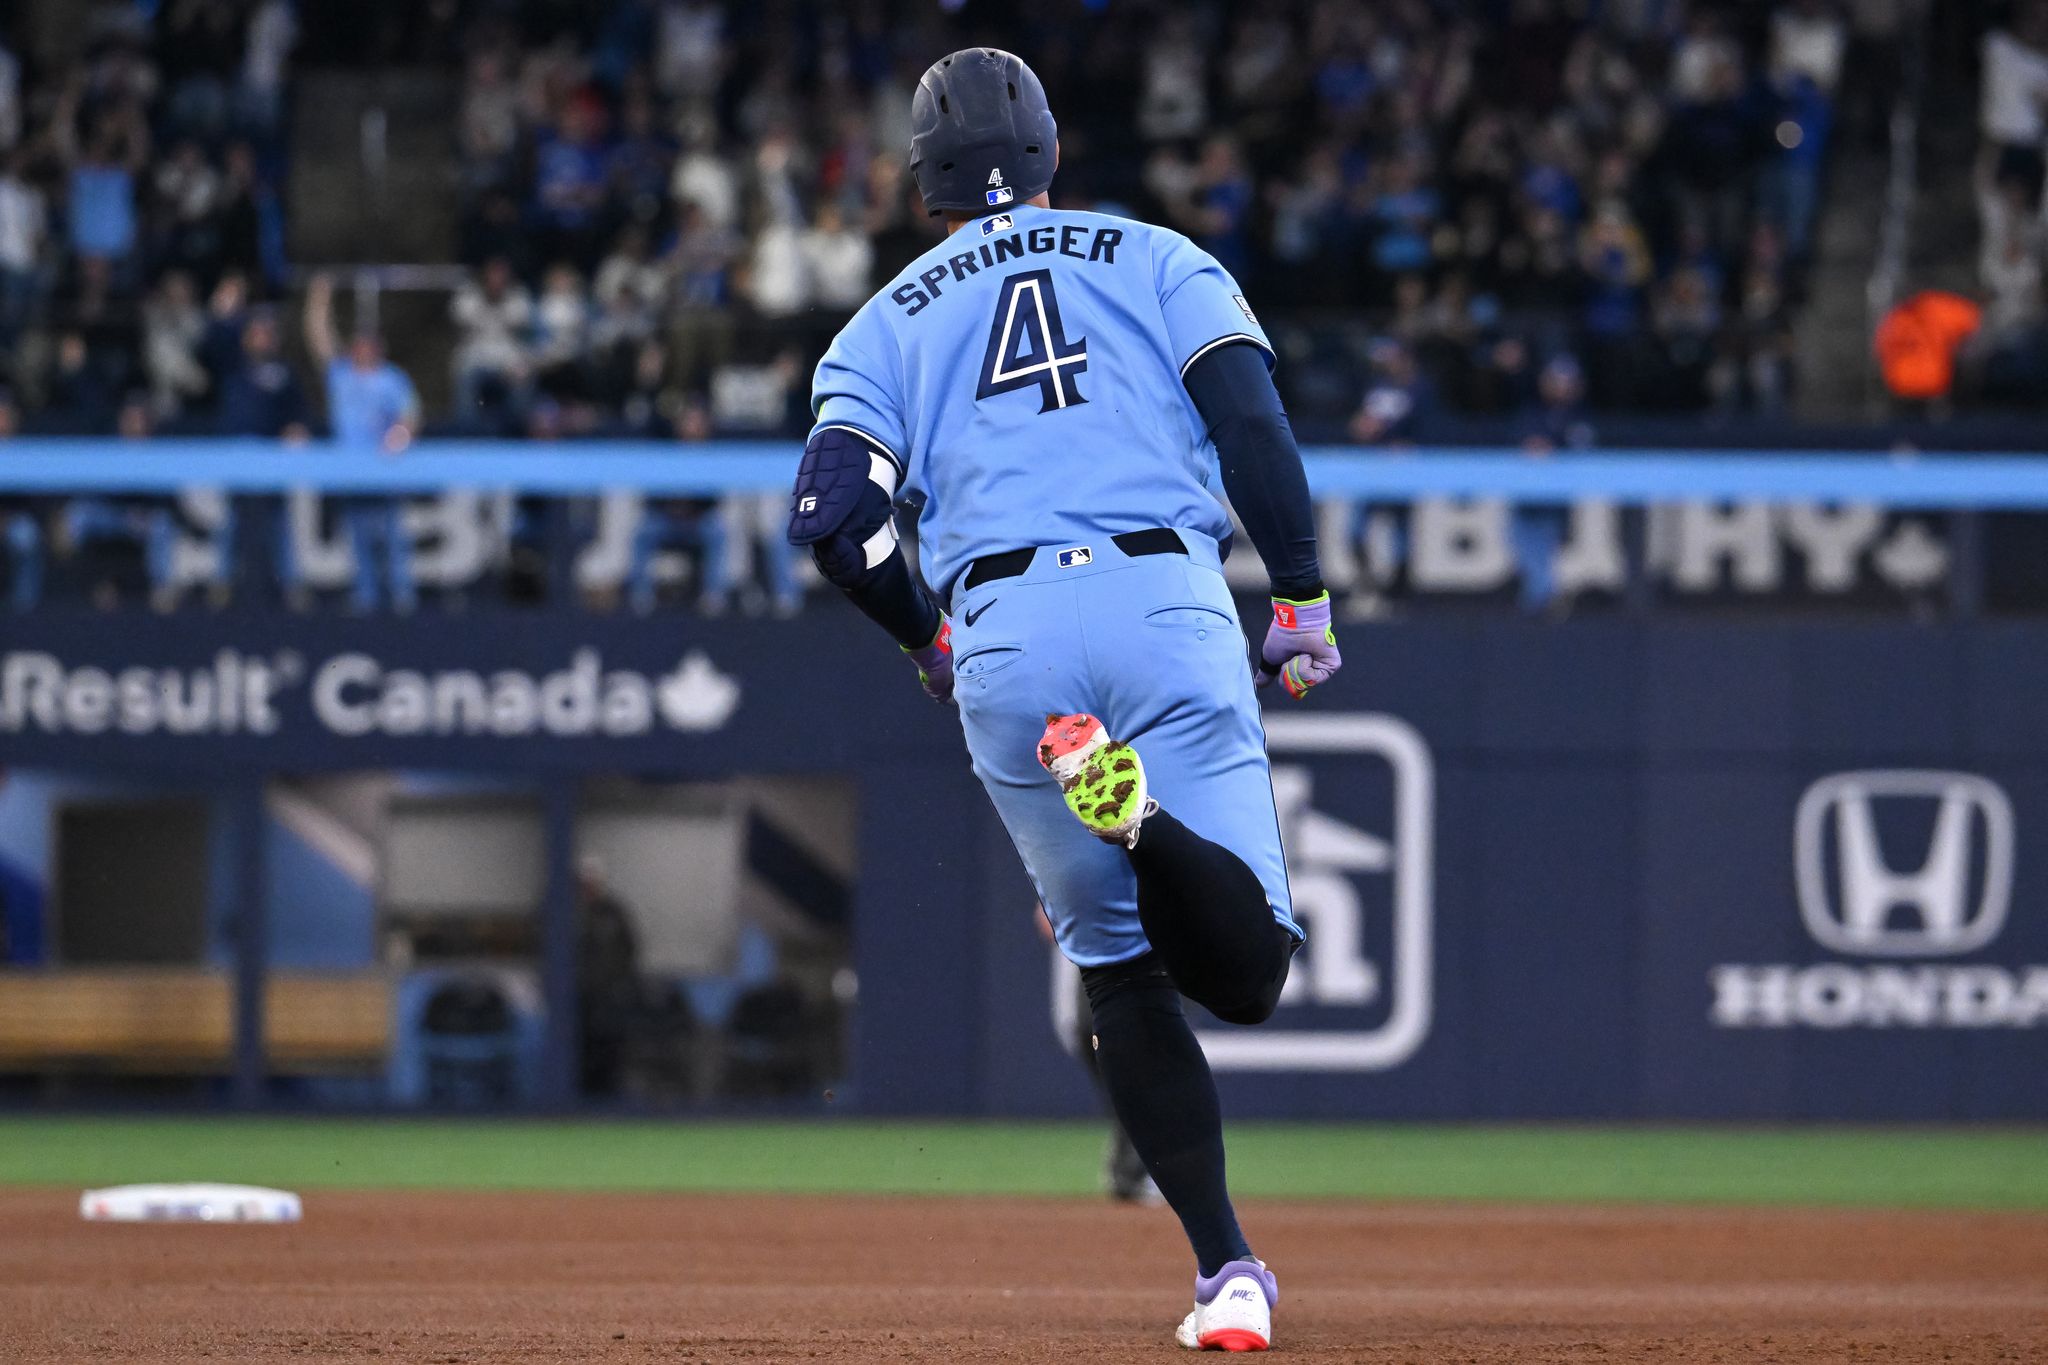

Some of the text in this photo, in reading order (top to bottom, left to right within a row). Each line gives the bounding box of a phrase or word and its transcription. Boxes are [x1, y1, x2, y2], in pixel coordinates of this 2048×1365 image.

[988, 168, 1003, 187] 4
[891, 225, 1123, 317] SPRINGER
[975, 268, 1090, 415] 4
[312, 648, 653, 736] Canada
